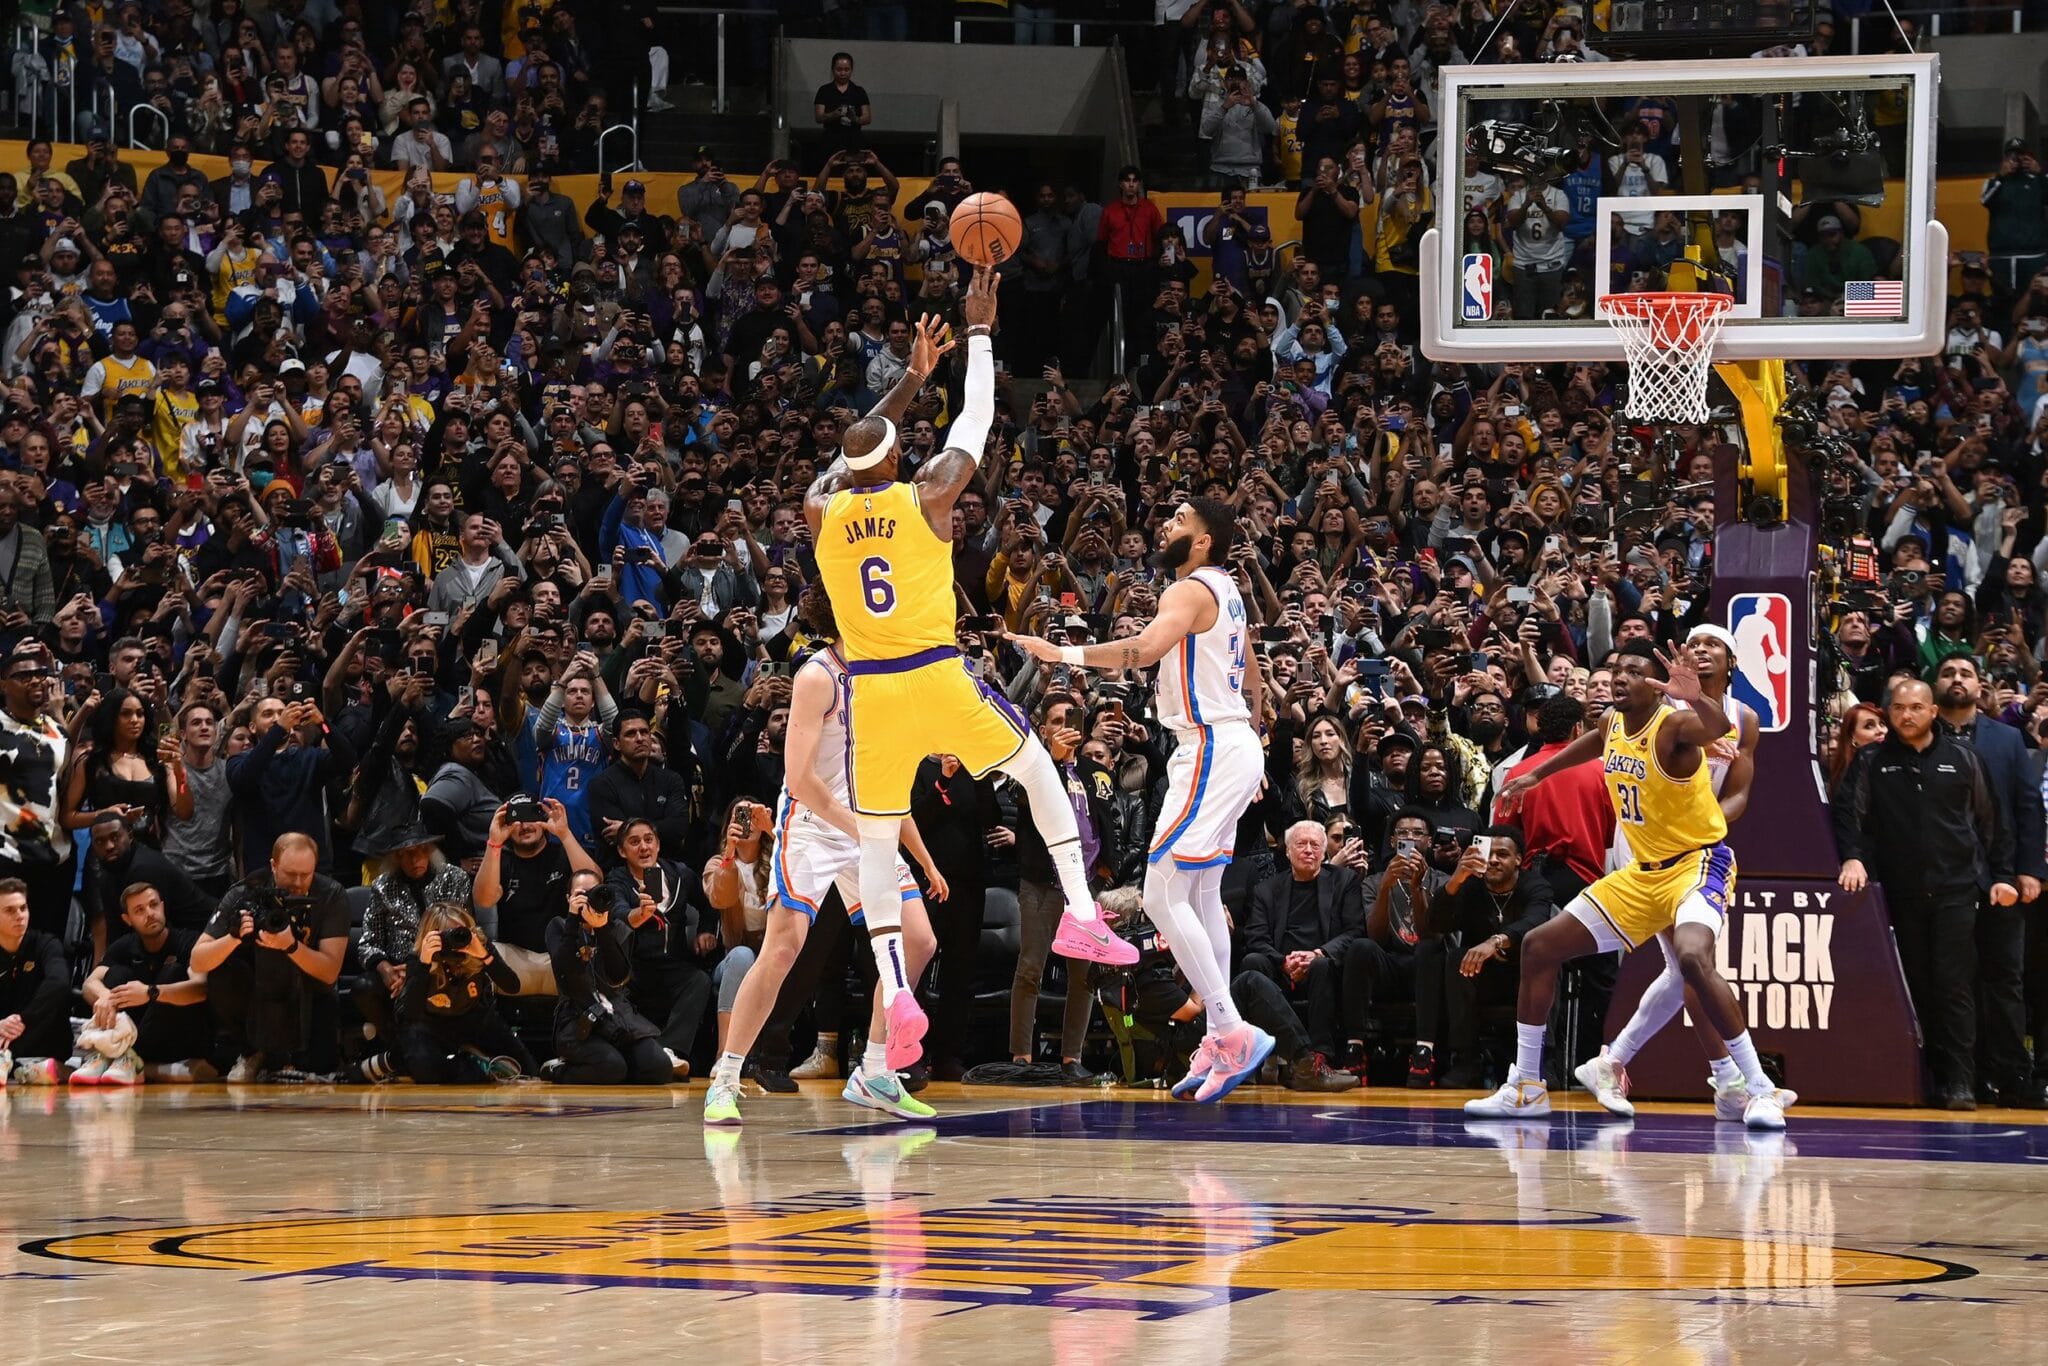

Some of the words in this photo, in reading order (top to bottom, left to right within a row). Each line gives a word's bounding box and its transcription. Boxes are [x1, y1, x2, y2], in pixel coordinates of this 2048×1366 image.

[1577, 196, 1592, 213] 12
[1532, 222, 1542, 241] 6
[1465, 304, 1482, 317] NBA
[847, 517, 896, 544] JAMES
[858, 556, 897, 616] 6
[553, 744, 603, 766] THUNDER
[566, 766, 581, 790] 2
[1616, 783, 1644, 823] 31
[1793, 892, 1832, 909] BY
[1715, 912, 1835, 983] LACK
